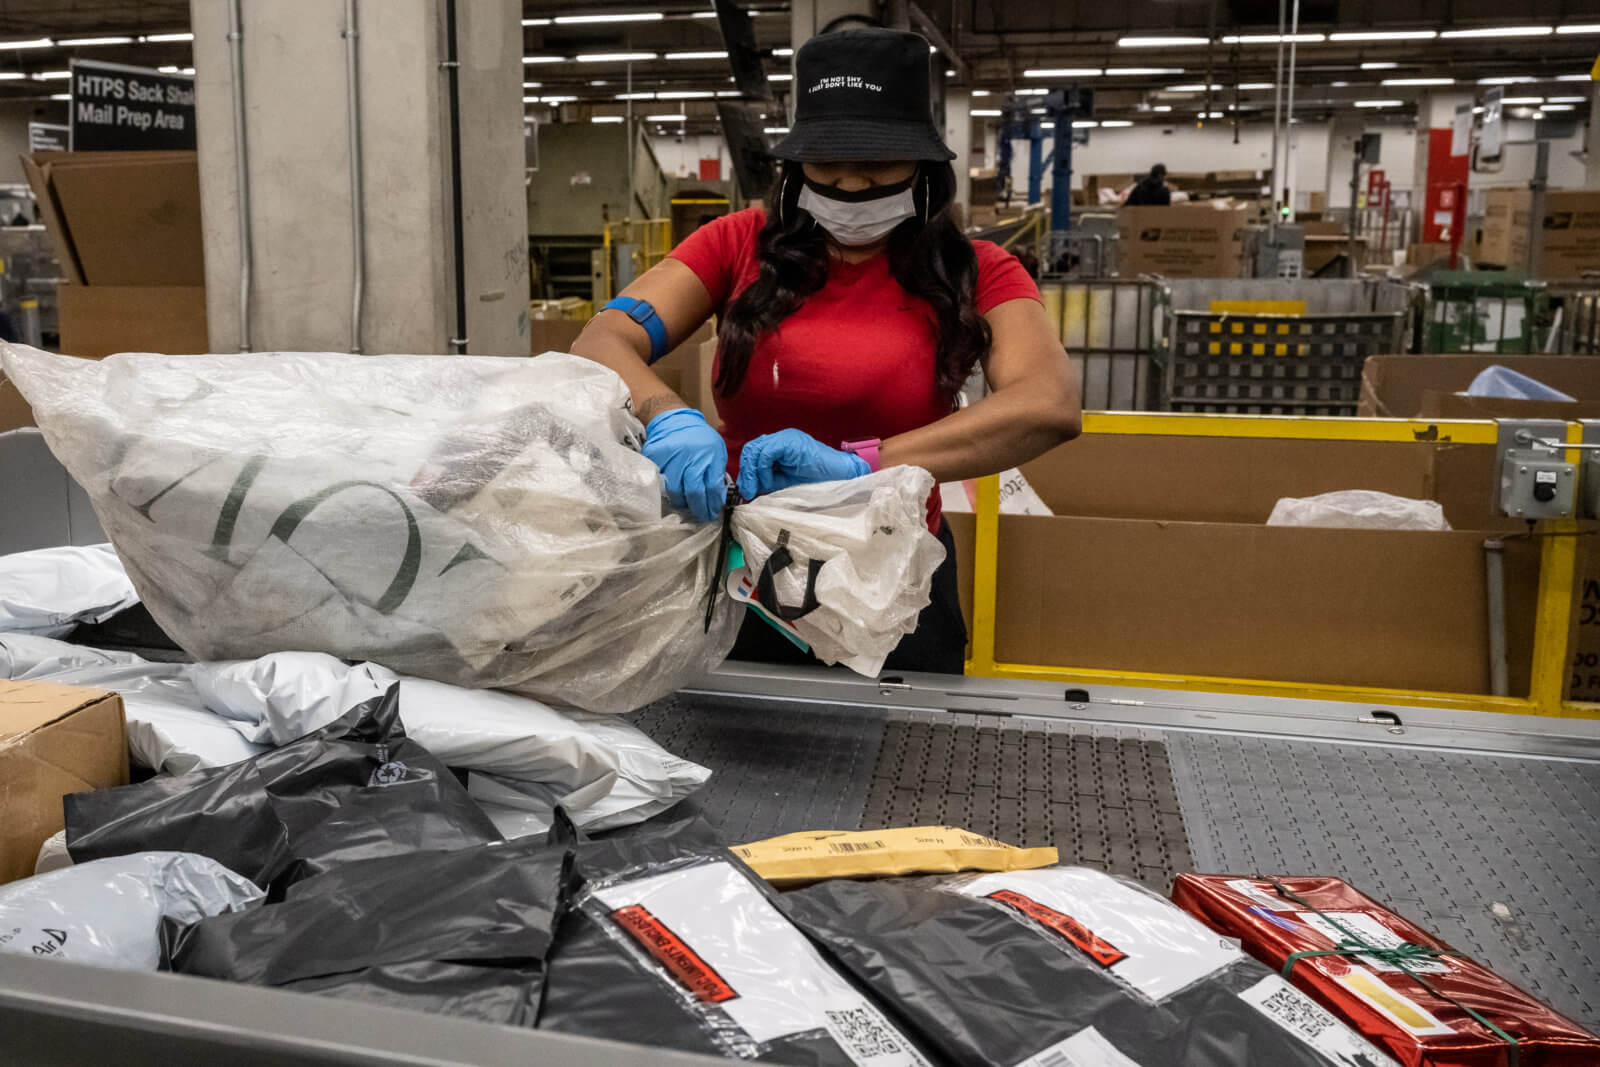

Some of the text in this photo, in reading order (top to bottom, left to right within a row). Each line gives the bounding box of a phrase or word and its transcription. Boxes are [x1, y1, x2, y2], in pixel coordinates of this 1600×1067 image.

[78, 75, 125, 99] HTPS
[128, 80, 163, 102] Sack
[847, 80, 863, 88] LIKE
[865, 83, 882, 92] YOU
[78, 102, 184, 131] Mail Prep Area
